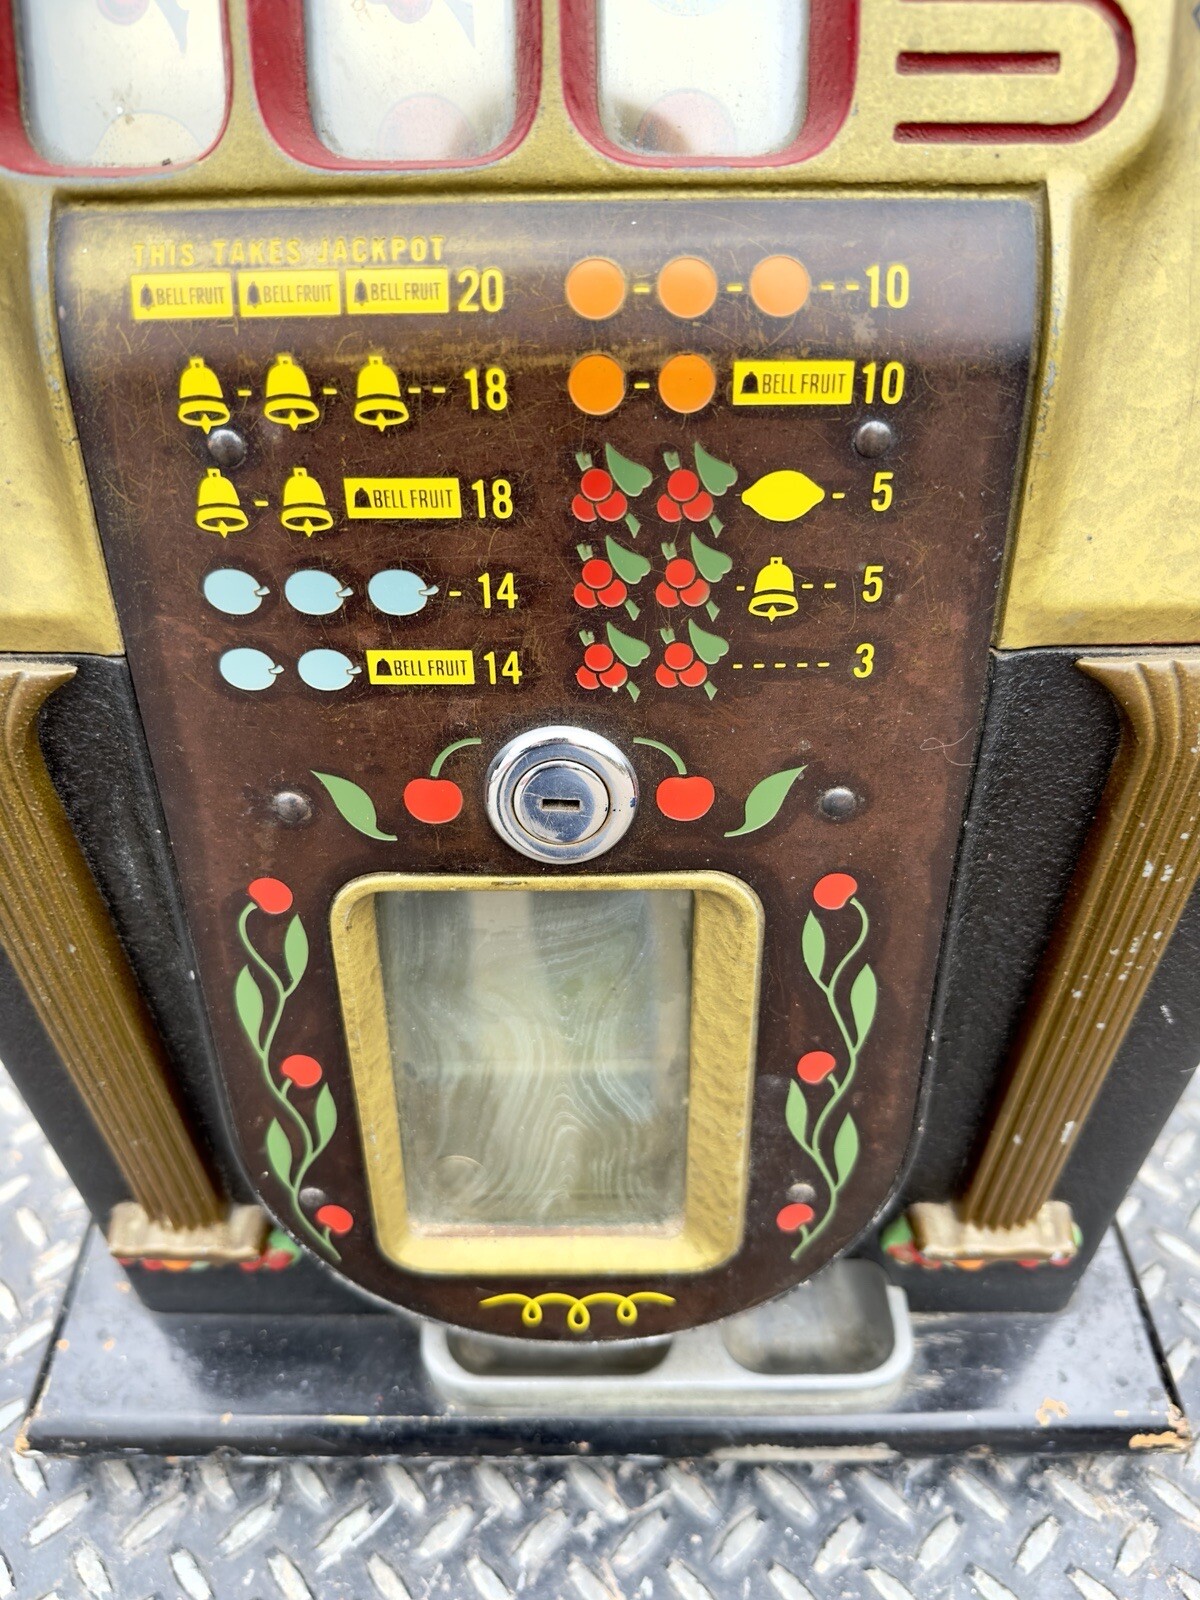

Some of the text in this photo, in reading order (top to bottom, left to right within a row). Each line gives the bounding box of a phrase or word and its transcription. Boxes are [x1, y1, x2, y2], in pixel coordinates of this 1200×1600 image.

[133, 236, 444, 267] THIS TAKES JACKPOT
[156, 286, 224, 306] BELL FRUIT
[263, 283, 333, 304] BELL FRUIT
[371, 281, 441, 301] BELL FRUIT
[457, 268, 504, 312] 20
[865, 265, 909, 308] 10
[464, 367, 508, 411] 18
[762, 373, 846, 394] BELL FRUIT
[862, 361, 905, 405] 10
[373, 489, 453, 508] BELL FRUIT
[471, 479, 513, 519] 18
[871, 472, 894, 511] 5
[477, 572, 518, 609] 14
[862, 566, 884, 602] 5
[393, 659, 467, 676] BELL FRUIT
[483, 651, 523, 685] 14
[853, 643, 875, 678] 3
